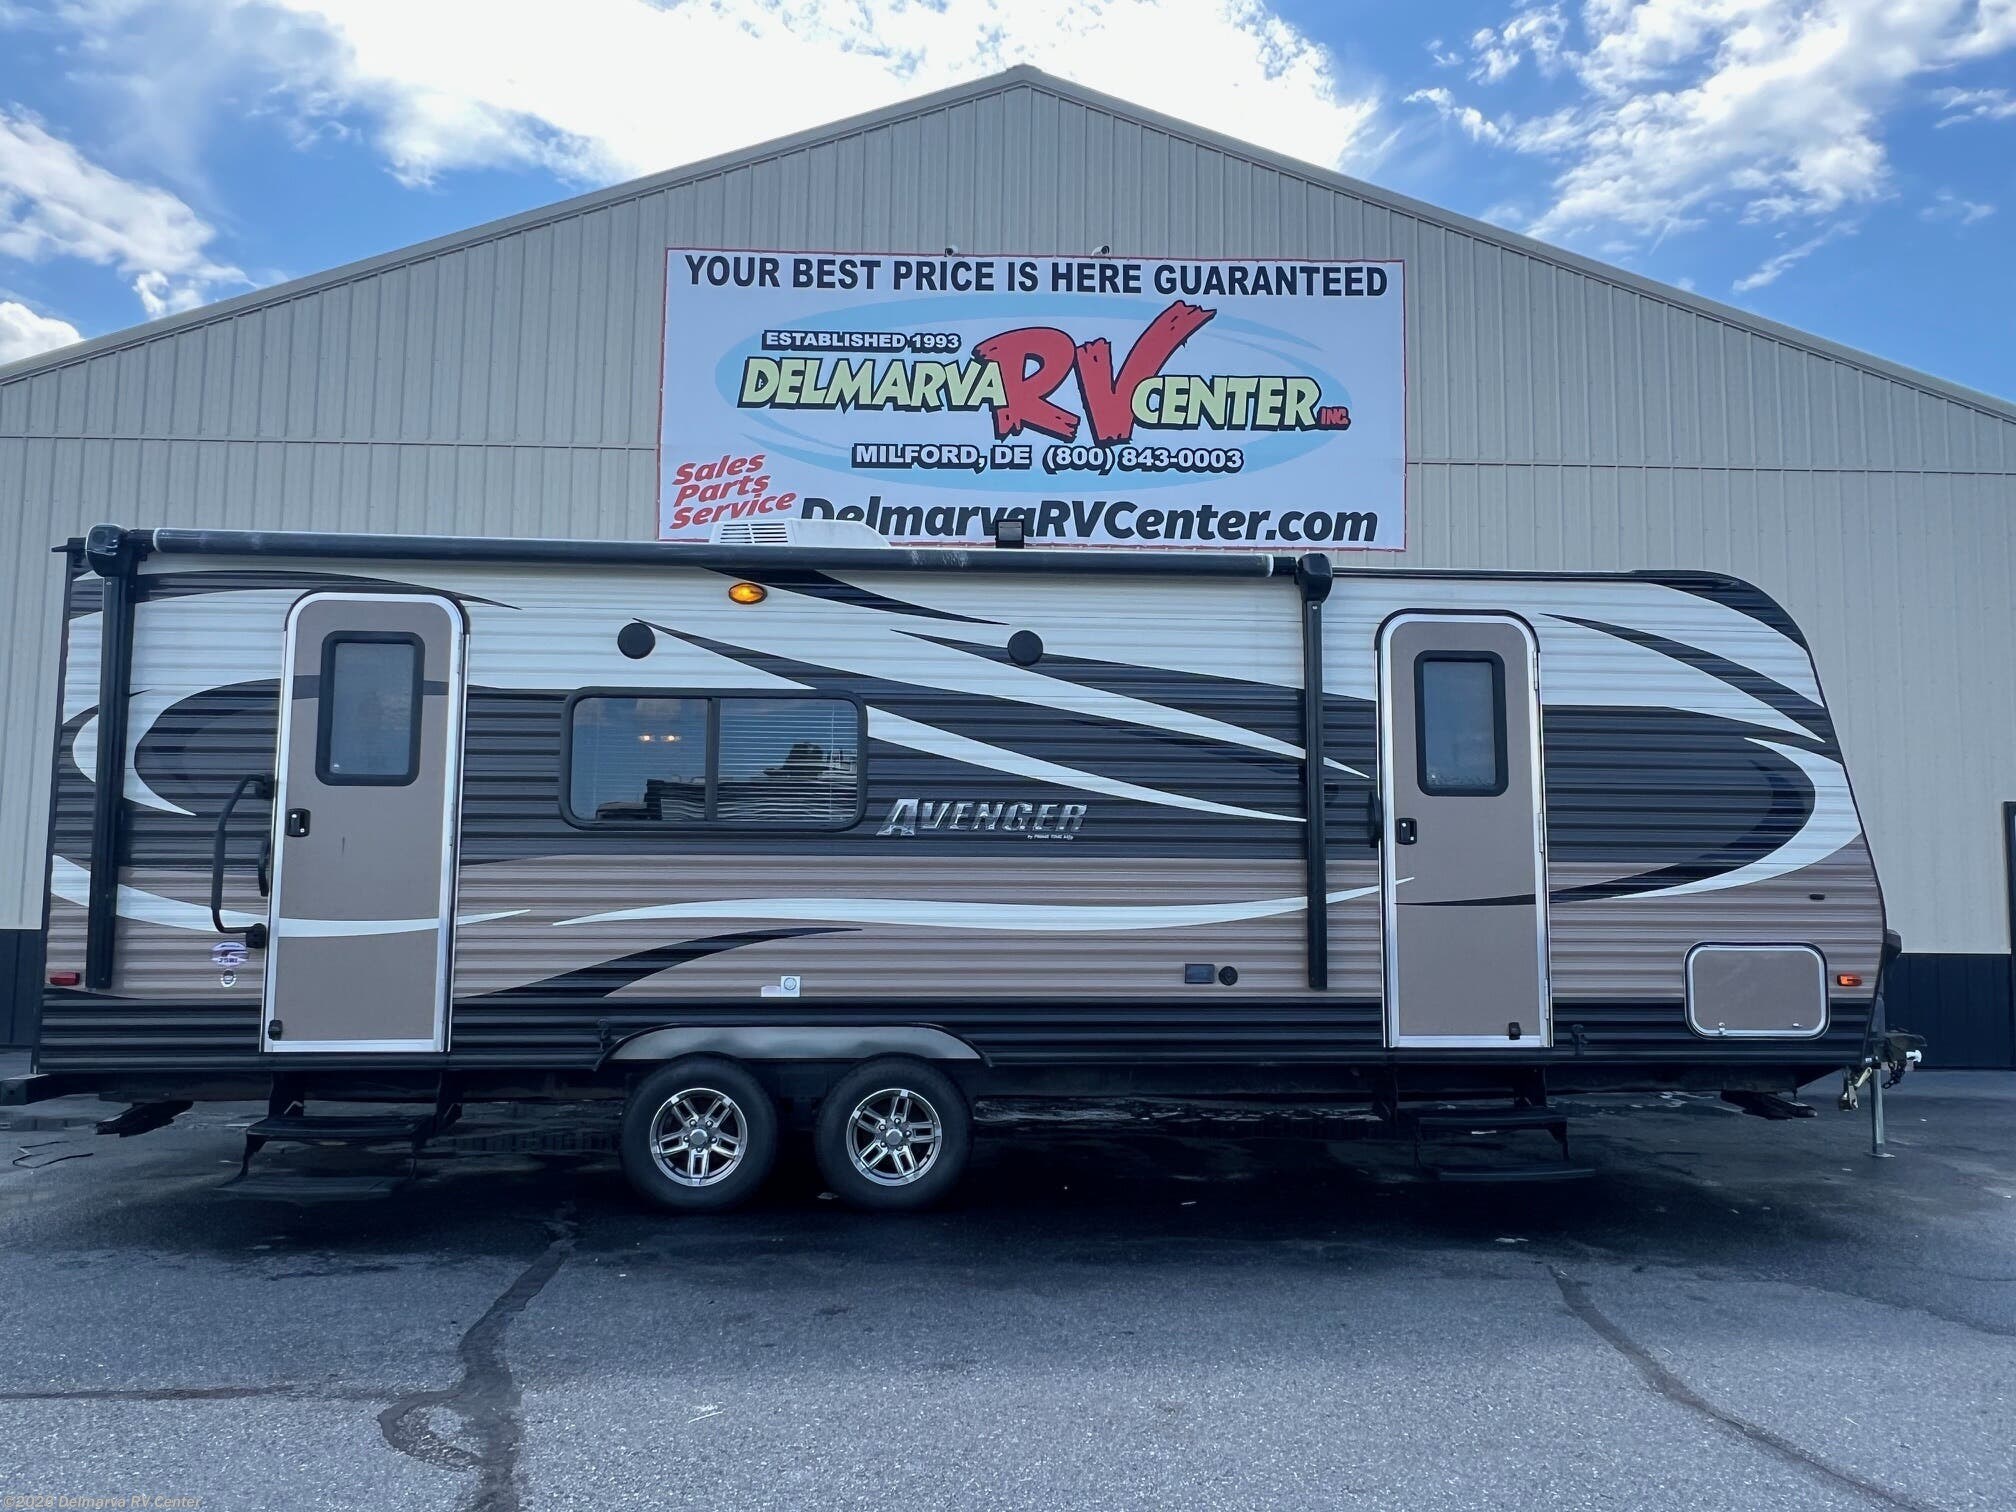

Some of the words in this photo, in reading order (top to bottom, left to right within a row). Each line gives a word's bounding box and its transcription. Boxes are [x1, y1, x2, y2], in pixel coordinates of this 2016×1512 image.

[684, 254, 781, 289] YOUR
[792, 258, 882, 291] BEST
[893, 261, 995, 292] PRICE
[1007, 262, 1039, 293] IS
[1051, 262, 1143, 294] HERE
[1153, 265, 1388, 297] GUARANTEED
[764, 331, 907, 350] ESTABLISHED
[910, 334, 961, 351] 1993
[738, 357, 1008, 412] DELMARVA
[970, 300, 1218, 446] RV
[1130, 375, 1320, 430] CENTER
[1319, 406, 1350, 428] INC.
[672, 454, 766, 485] Sales
[854, 444, 988, 471] MILFORD,
[994, 445, 1032, 467] DE
[1045, 446, 1115, 472] (800)
[1121, 449, 1243, 471] 843-0003
[674, 475, 771, 507] Parts
[669, 492, 797, 529] Service
[875, 798, 1088, 837] AVENGER
